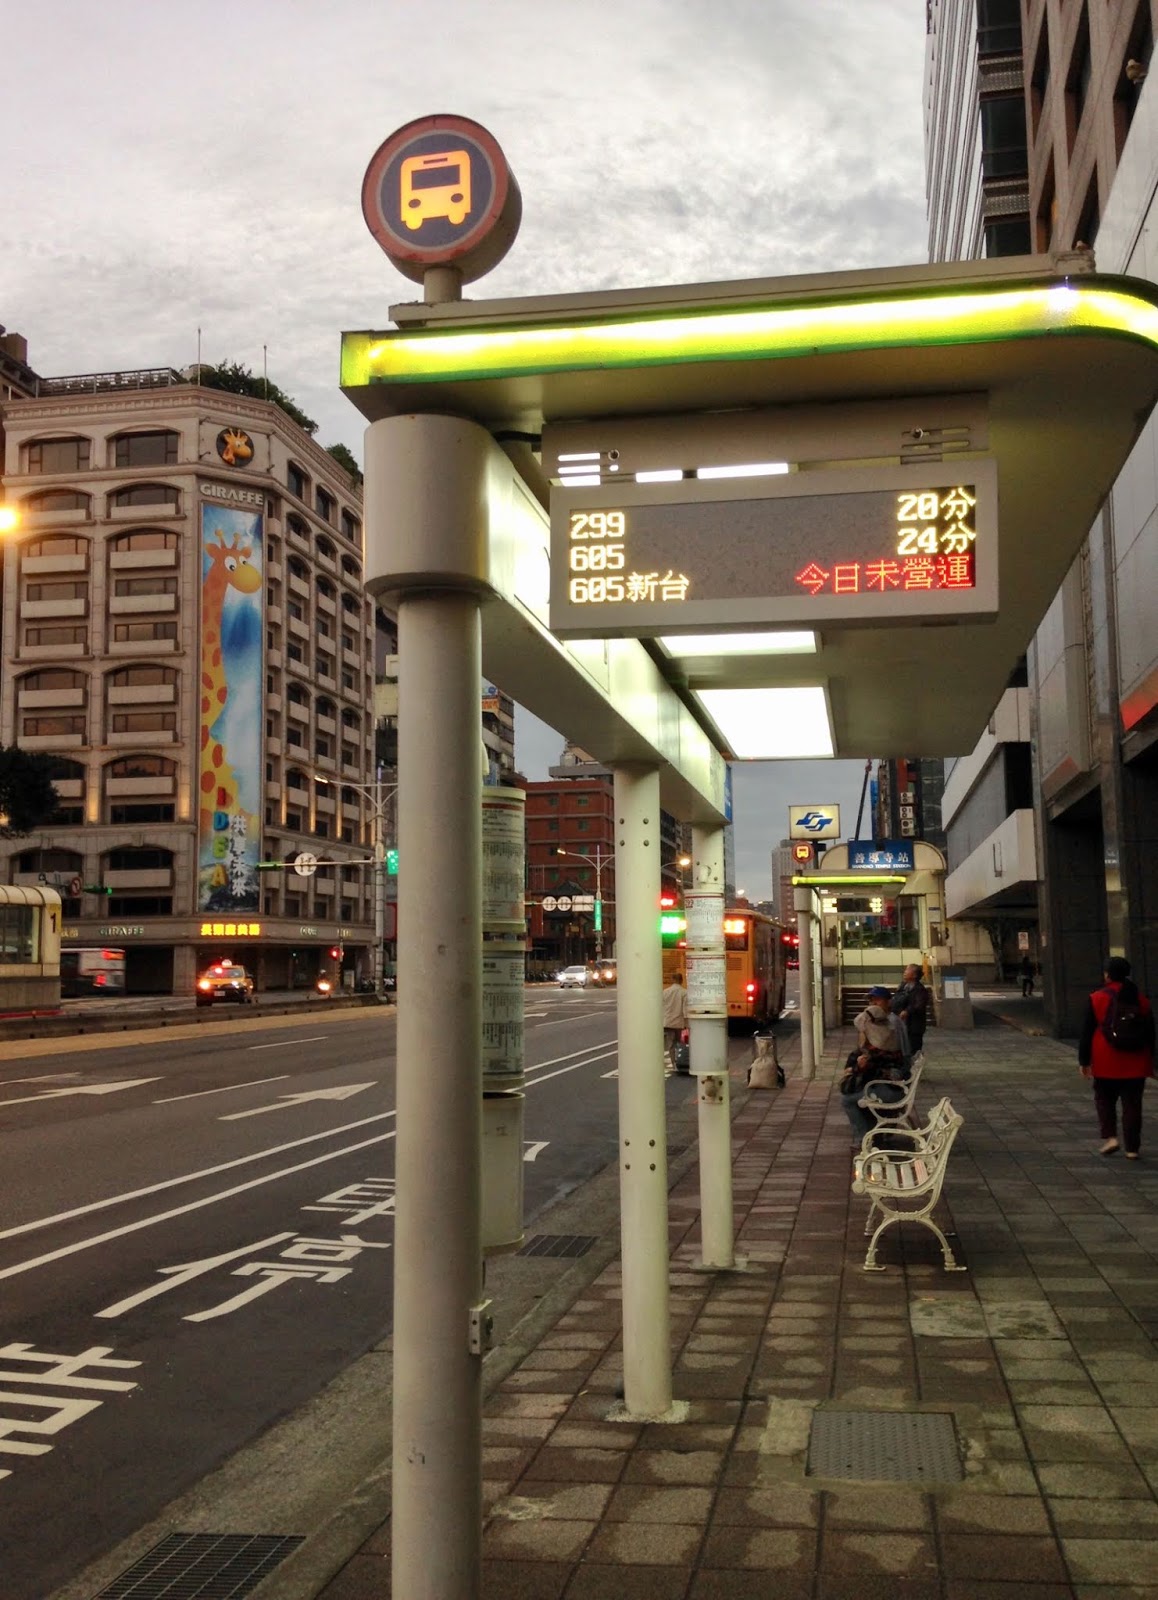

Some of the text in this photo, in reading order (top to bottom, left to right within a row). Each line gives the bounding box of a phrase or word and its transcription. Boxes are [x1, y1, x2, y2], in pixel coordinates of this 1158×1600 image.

[200, 483, 264, 506] GIRAFFE
[897, 487, 976, 521] 20分
[570, 511, 625, 539] 299
[897, 521, 976, 555] 24分
[570, 544, 625, 571] 605
[570, 570, 690, 603] 605新台
[796, 555, 972, 595] 今日未營運
